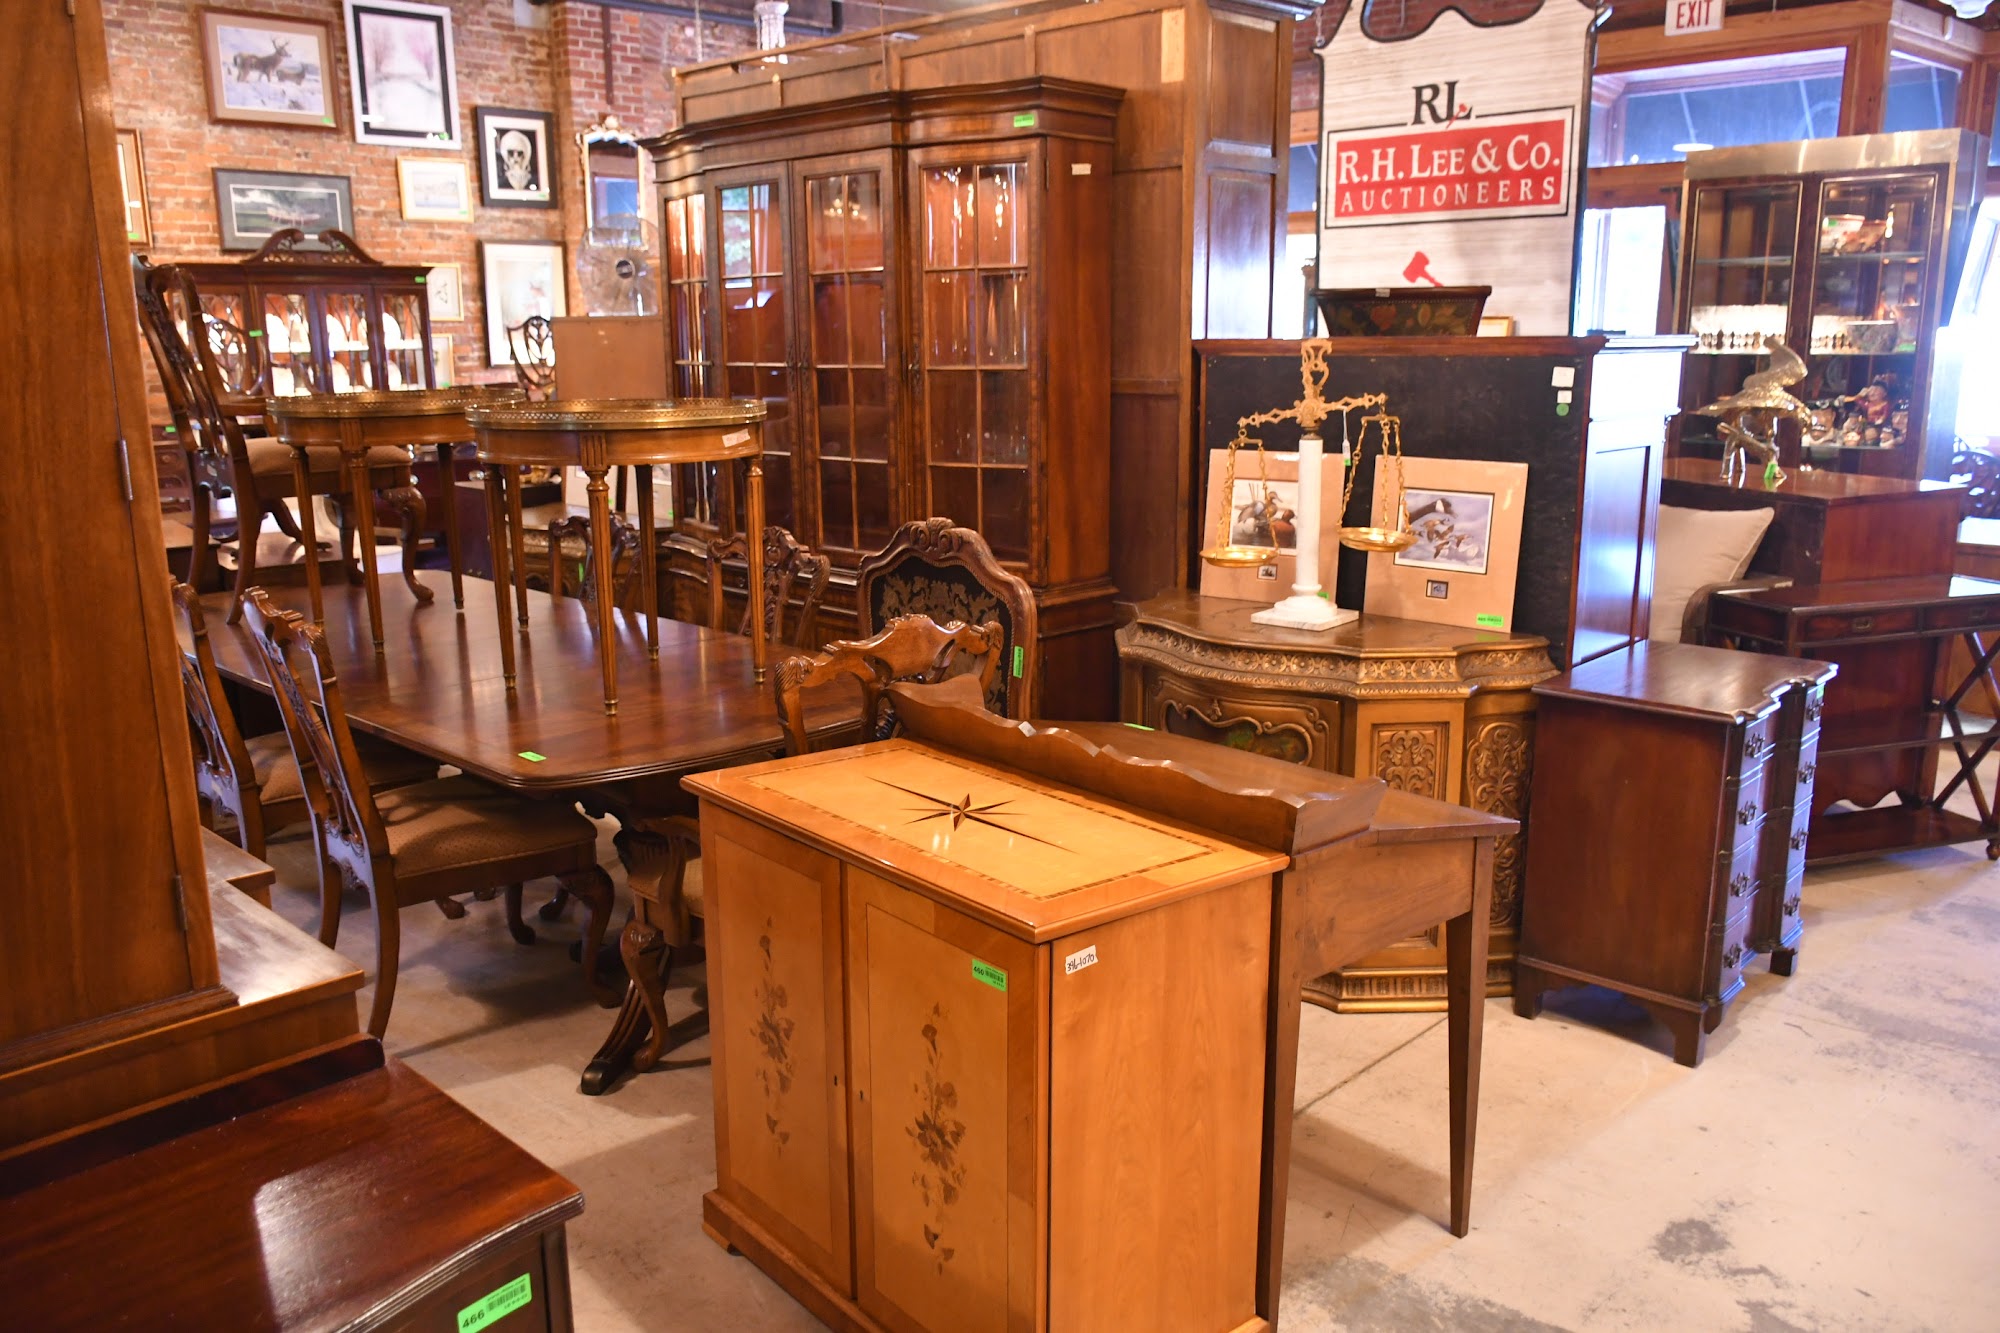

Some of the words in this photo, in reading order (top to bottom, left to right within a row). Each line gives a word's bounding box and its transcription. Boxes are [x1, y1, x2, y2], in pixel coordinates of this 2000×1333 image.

[1676, 0, 1713, 29] EXIT
[1338, 147, 1404, 184] R.H.
[1471, 138, 1502, 174] &
[1340, 176, 1556, 213] AUCTIONEERS
[462, 1308, 486, 1329] 466
